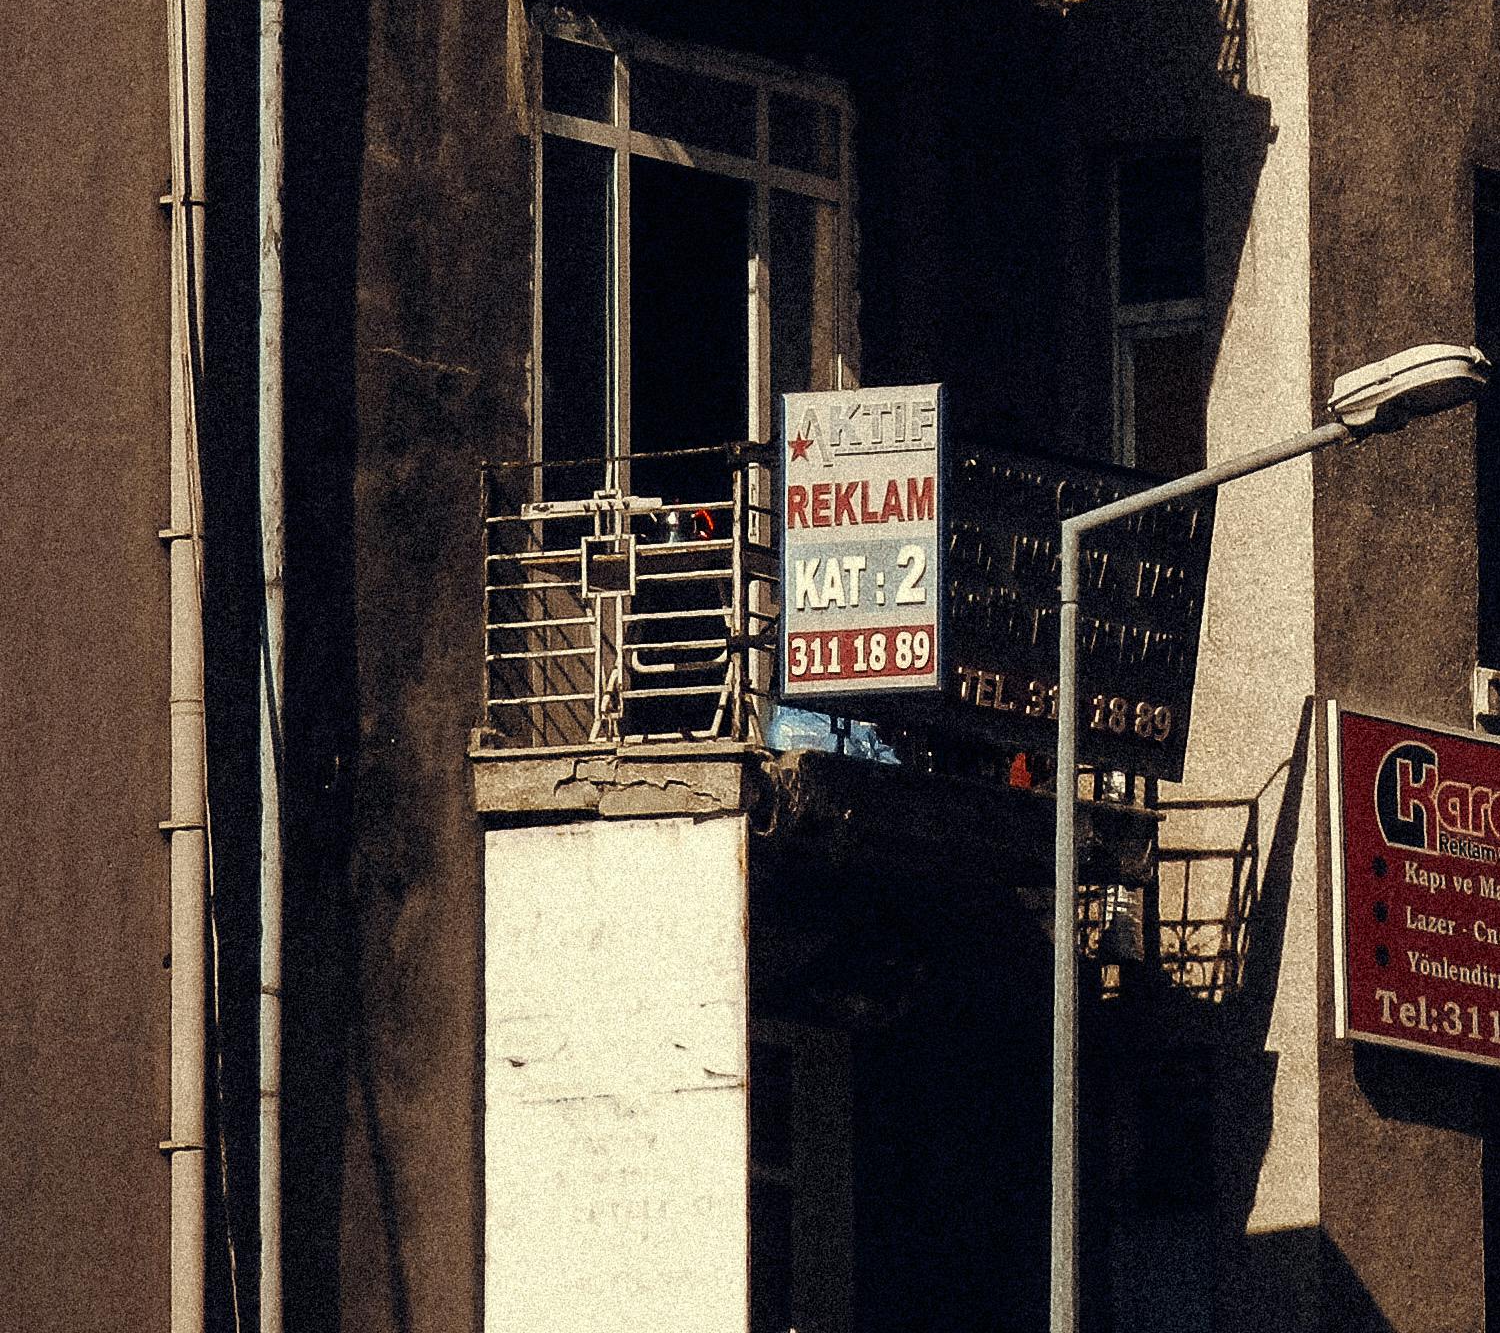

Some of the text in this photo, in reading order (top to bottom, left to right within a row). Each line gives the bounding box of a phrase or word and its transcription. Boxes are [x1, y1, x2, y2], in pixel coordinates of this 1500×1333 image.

[787, 476, 936, 530] REKLAM
[896, 543, 927, 606] 2
[791, 630, 931, 676] 311 18 89
[1026, 680, 1061, 720] 31
[1090, 694, 1127, 733] 18
[1135, 701, 1172, 742] 89
[1439, 831, 1497, 866] Reklam
[1404, 859, 1447, 894] Kapı
[1453, 876, 1473, 895] ve
[1406, 905, 1456, 937] Lazer
